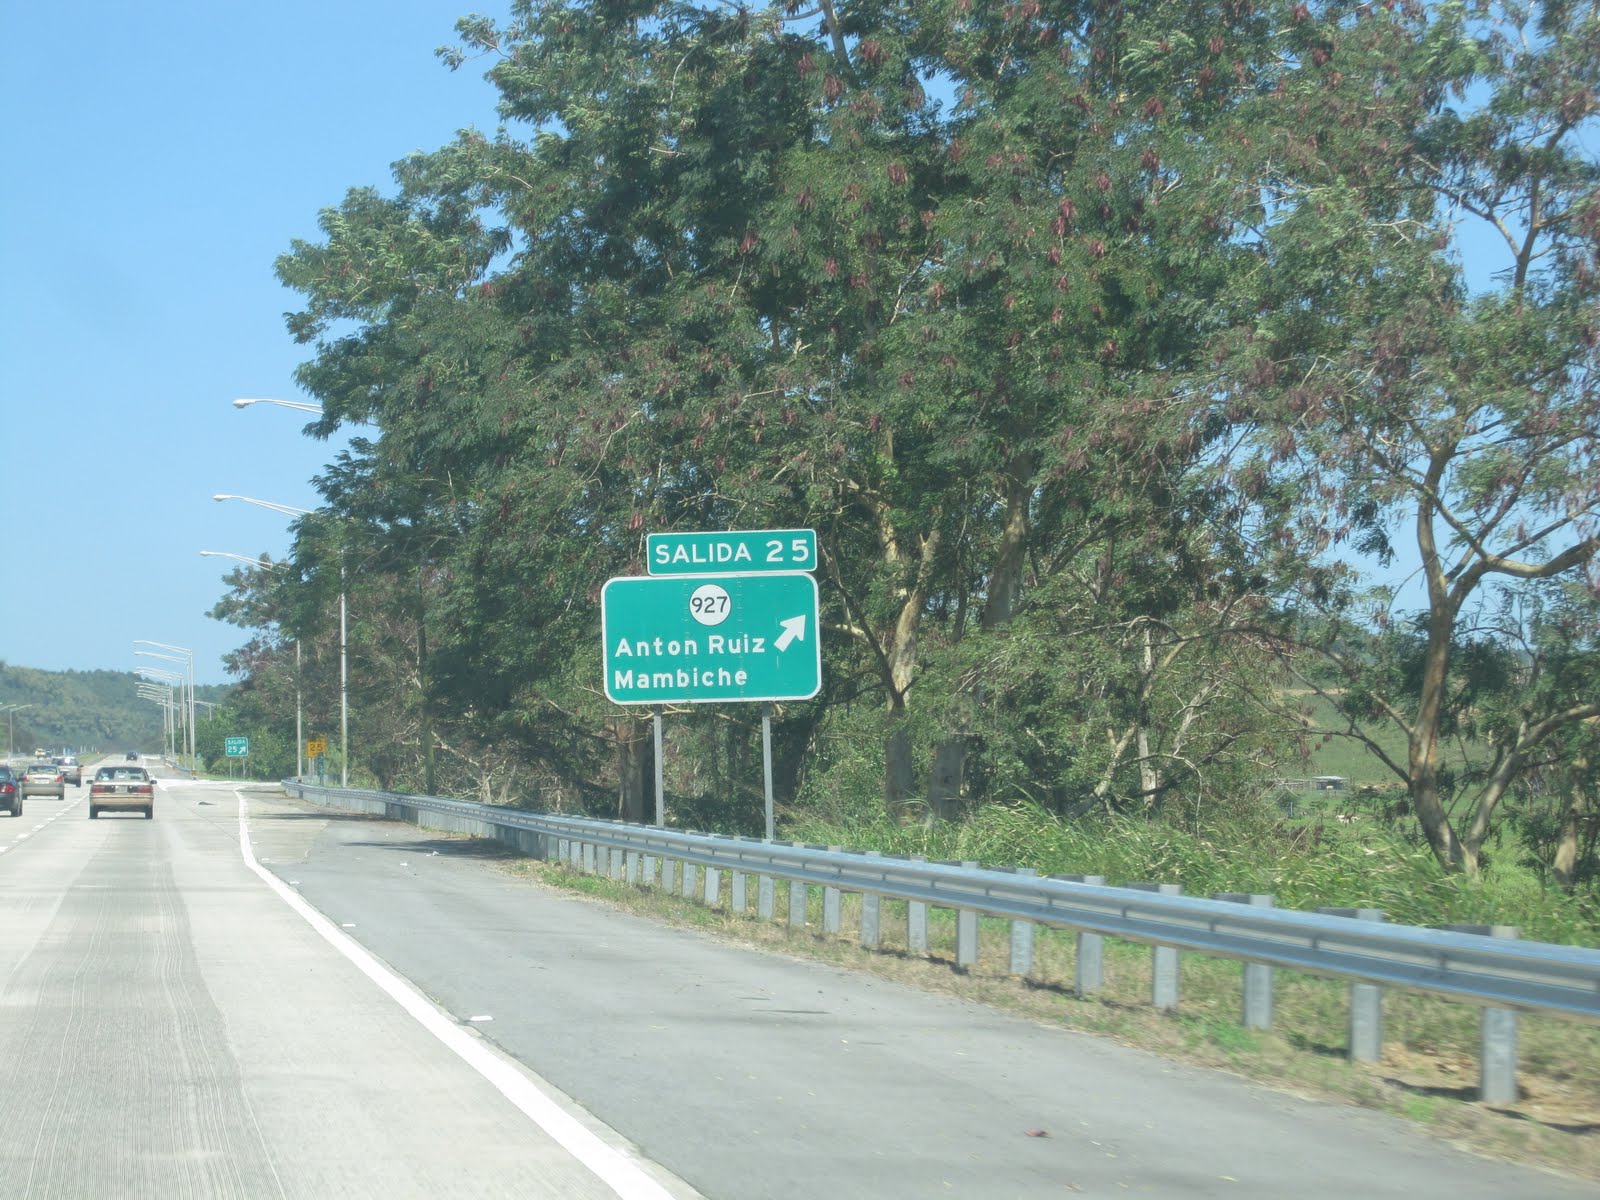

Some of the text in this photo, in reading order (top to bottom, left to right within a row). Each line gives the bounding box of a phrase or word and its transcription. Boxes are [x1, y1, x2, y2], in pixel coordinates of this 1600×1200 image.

[655, 539, 809, 565] SALIDA 25
[691, 596, 728, 613] 927
[614, 634, 766, 658] Anton Ruiz
[614, 667, 748, 690] Mambiche
[309, 743, 323, 751] 25
